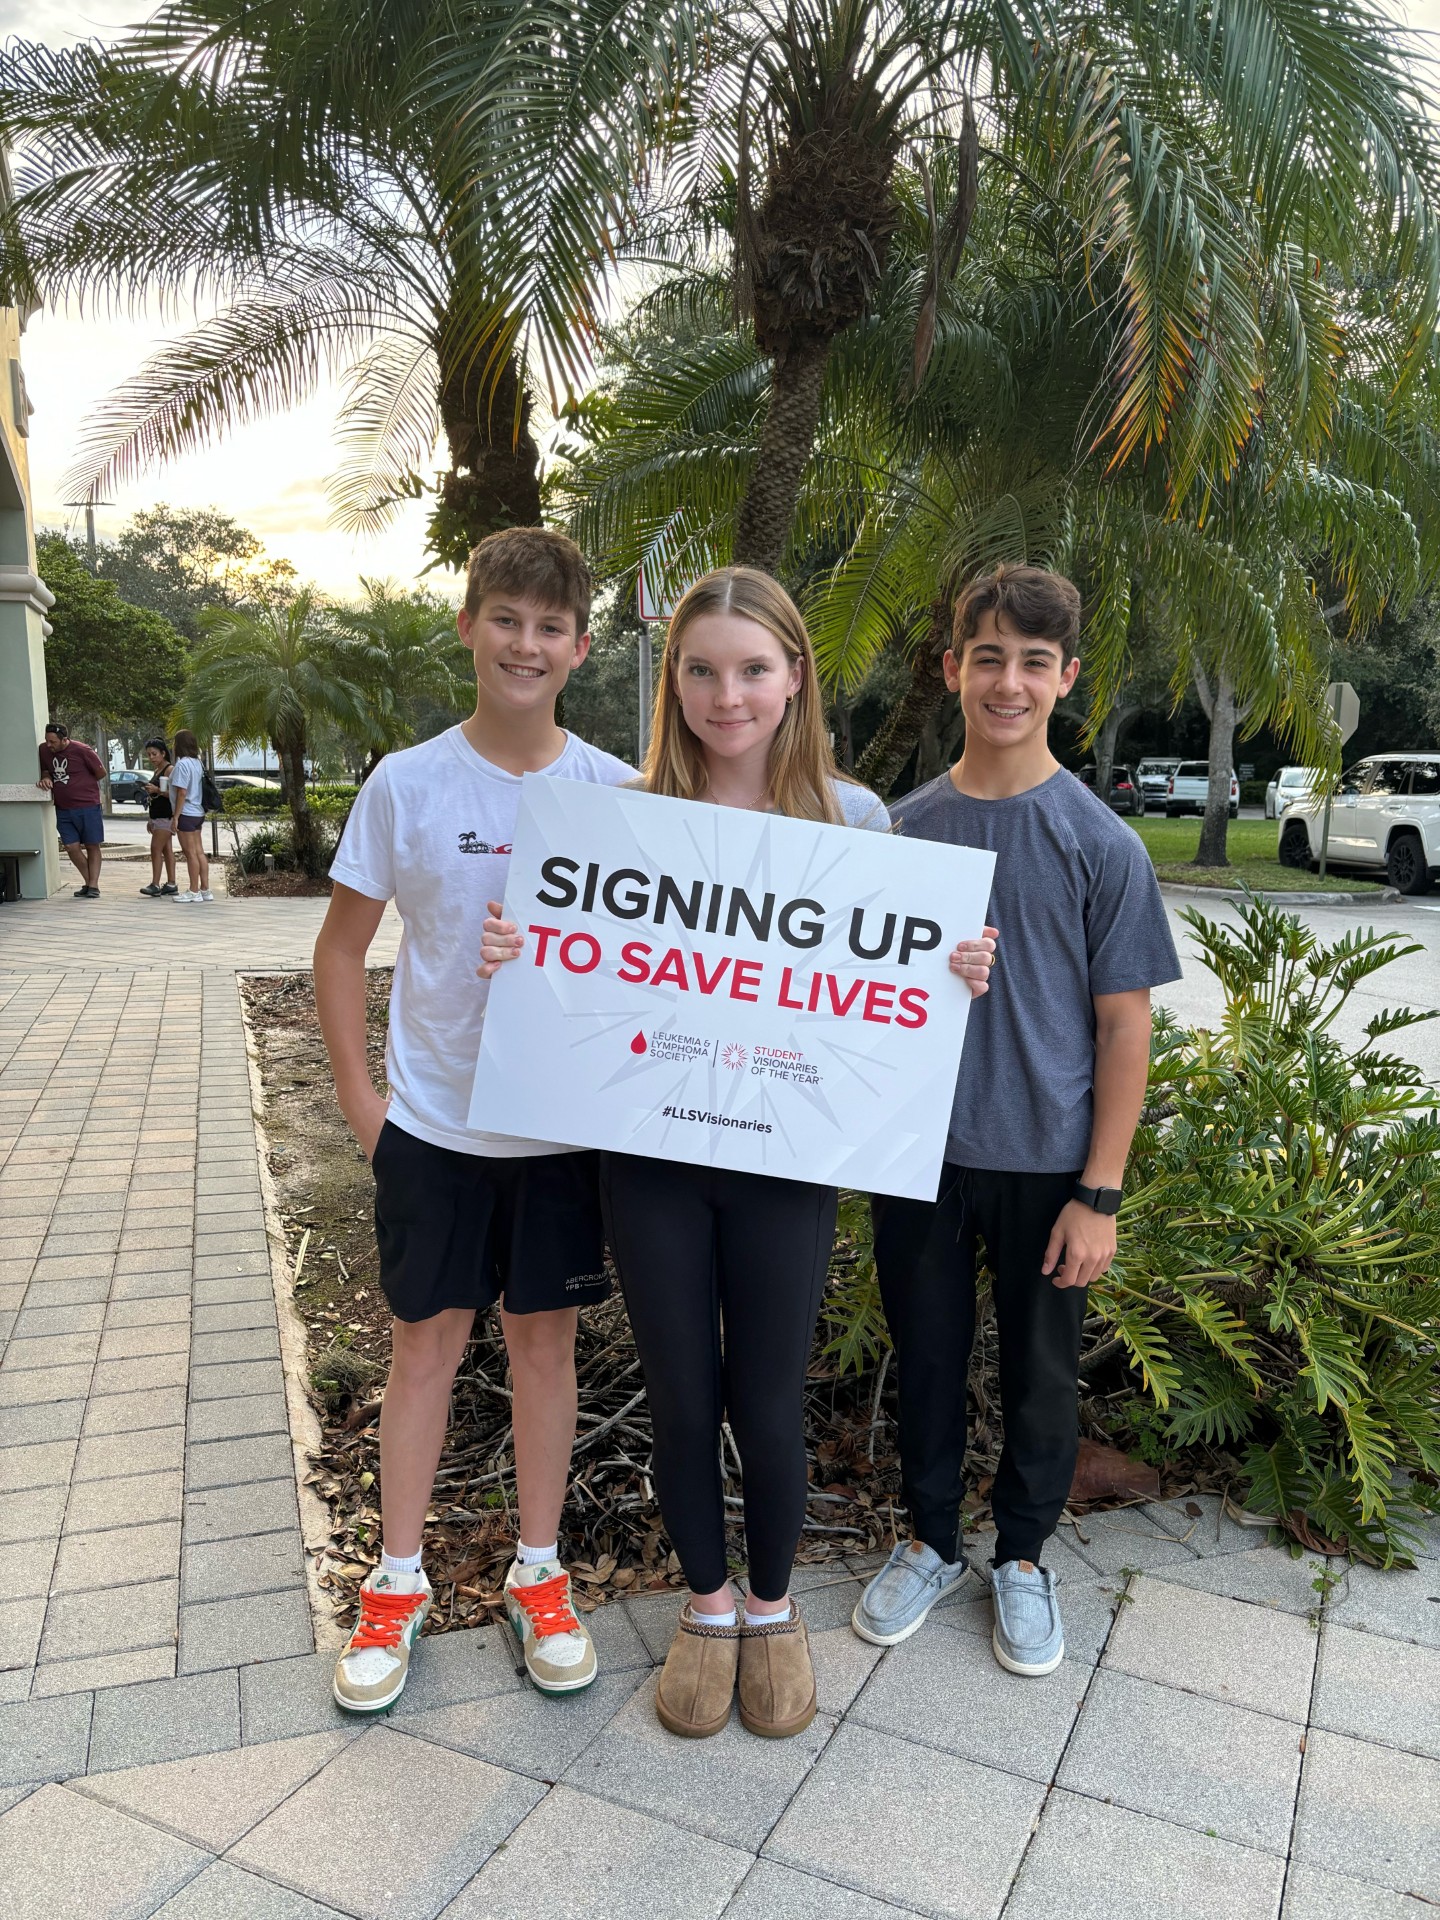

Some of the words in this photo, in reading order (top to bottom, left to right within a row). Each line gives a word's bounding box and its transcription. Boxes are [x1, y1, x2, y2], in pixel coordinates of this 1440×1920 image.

[536, 857, 826, 949] SIGNING
[848, 907, 942, 966] UP
[528, 925, 602, 974] TO
[616, 941, 763, 1003] SAVE
[777, 967, 930, 1029] LIVES
[651, 1040, 709, 1057] LYMPHOMA
[652, 1031, 701, 1047] LEUKEMIA
[703, 1039, 711, 1048] &
[754, 1046, 804, 1062] STUDENT
[750, 1066, 766, 1076] OF
[769, 1069, 789, 1080] THE
[753, 1056, 818, 1075] VISIONARIES
[662, 1105, 773, 1134] #LLSVisionaries
